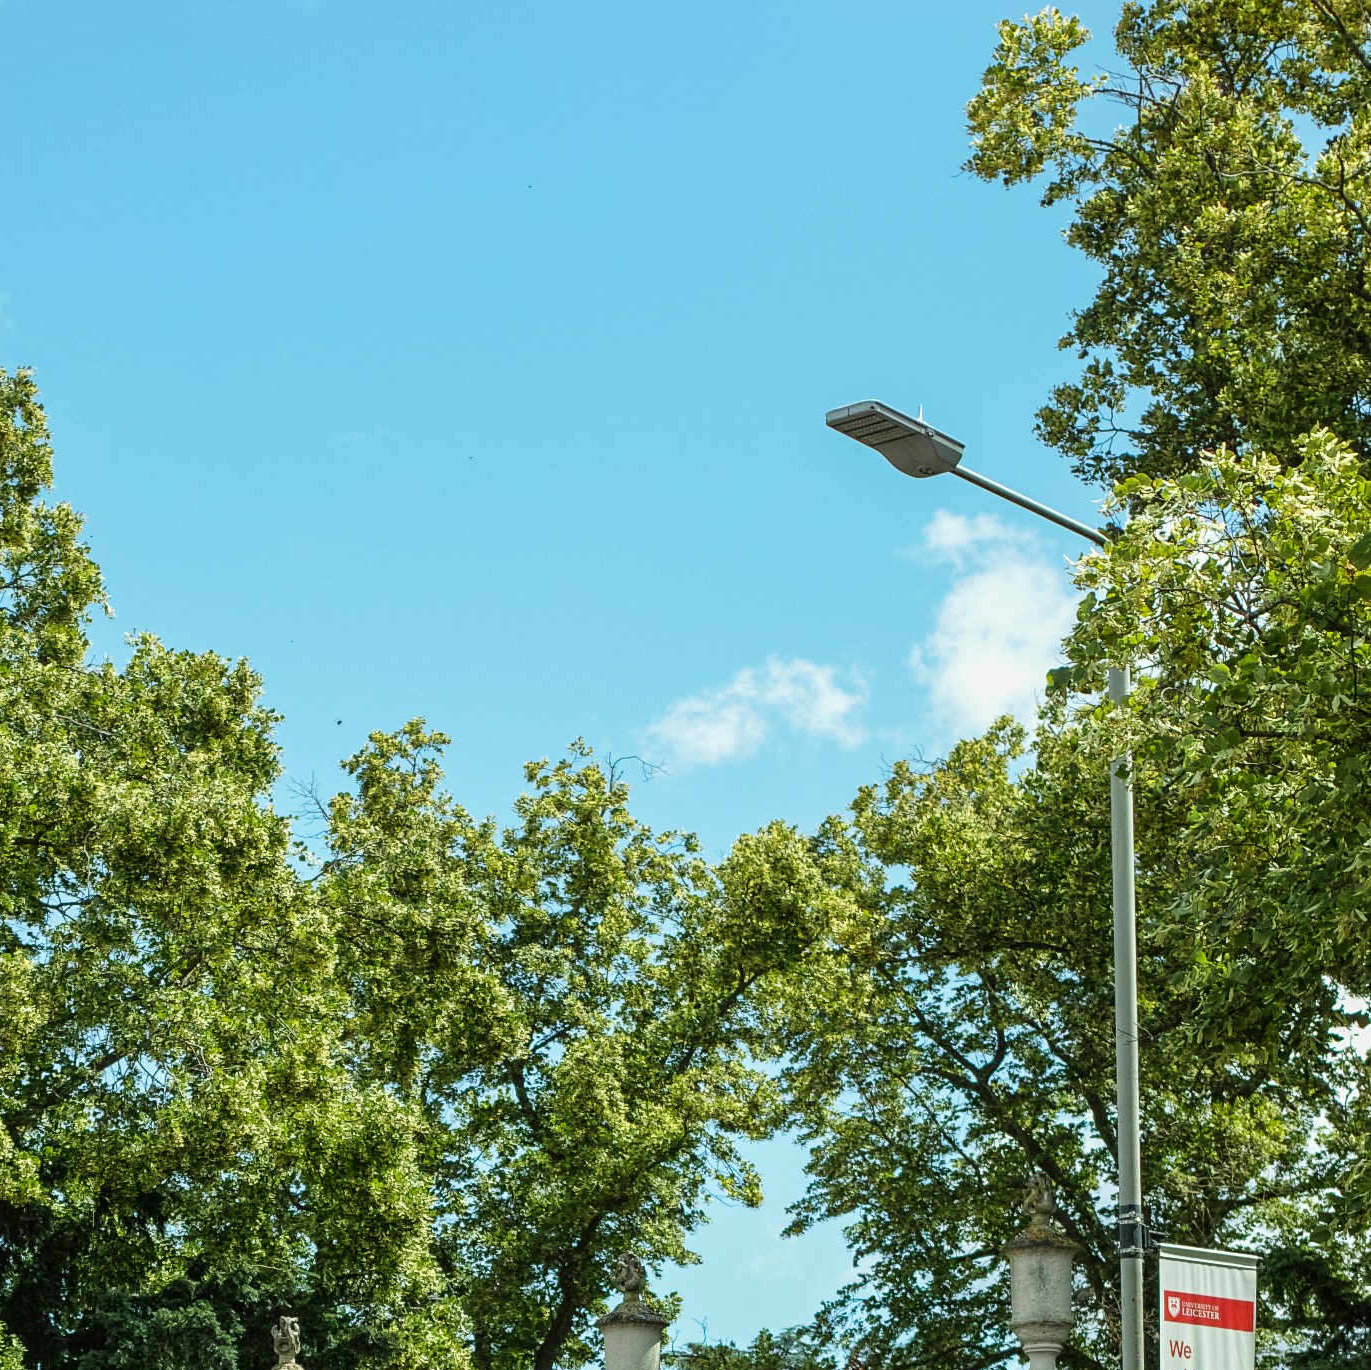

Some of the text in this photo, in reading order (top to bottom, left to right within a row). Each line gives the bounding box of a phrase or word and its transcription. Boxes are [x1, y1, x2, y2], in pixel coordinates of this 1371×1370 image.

[1181, 1301, 1211, 1311] UNIVERSITY
[1182, 1307, 1220, 1320] LEICESTER
[1169, 1339, 1191, 1359] We
